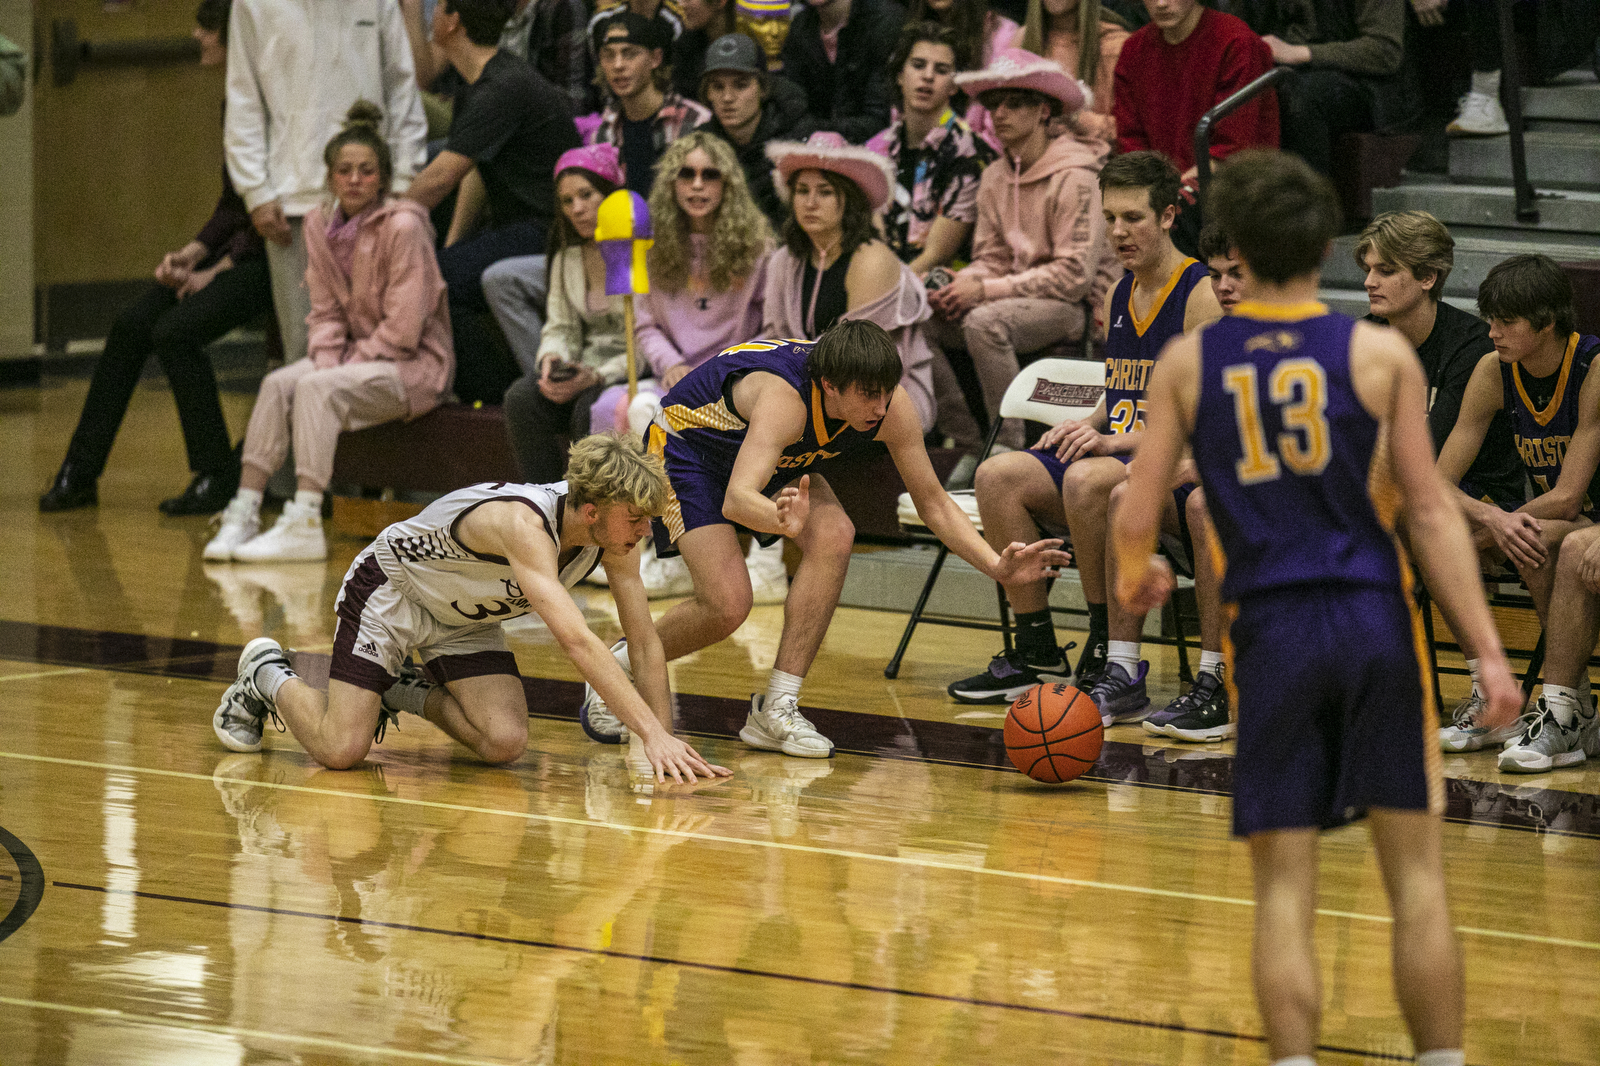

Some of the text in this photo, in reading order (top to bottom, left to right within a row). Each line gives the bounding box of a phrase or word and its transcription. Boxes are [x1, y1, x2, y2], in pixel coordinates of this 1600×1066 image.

[1037, 381, 1105, 399] PARCHMENT
[1221, 356, 1333, 485] 13
[358, 646, 379, 658] adidas
